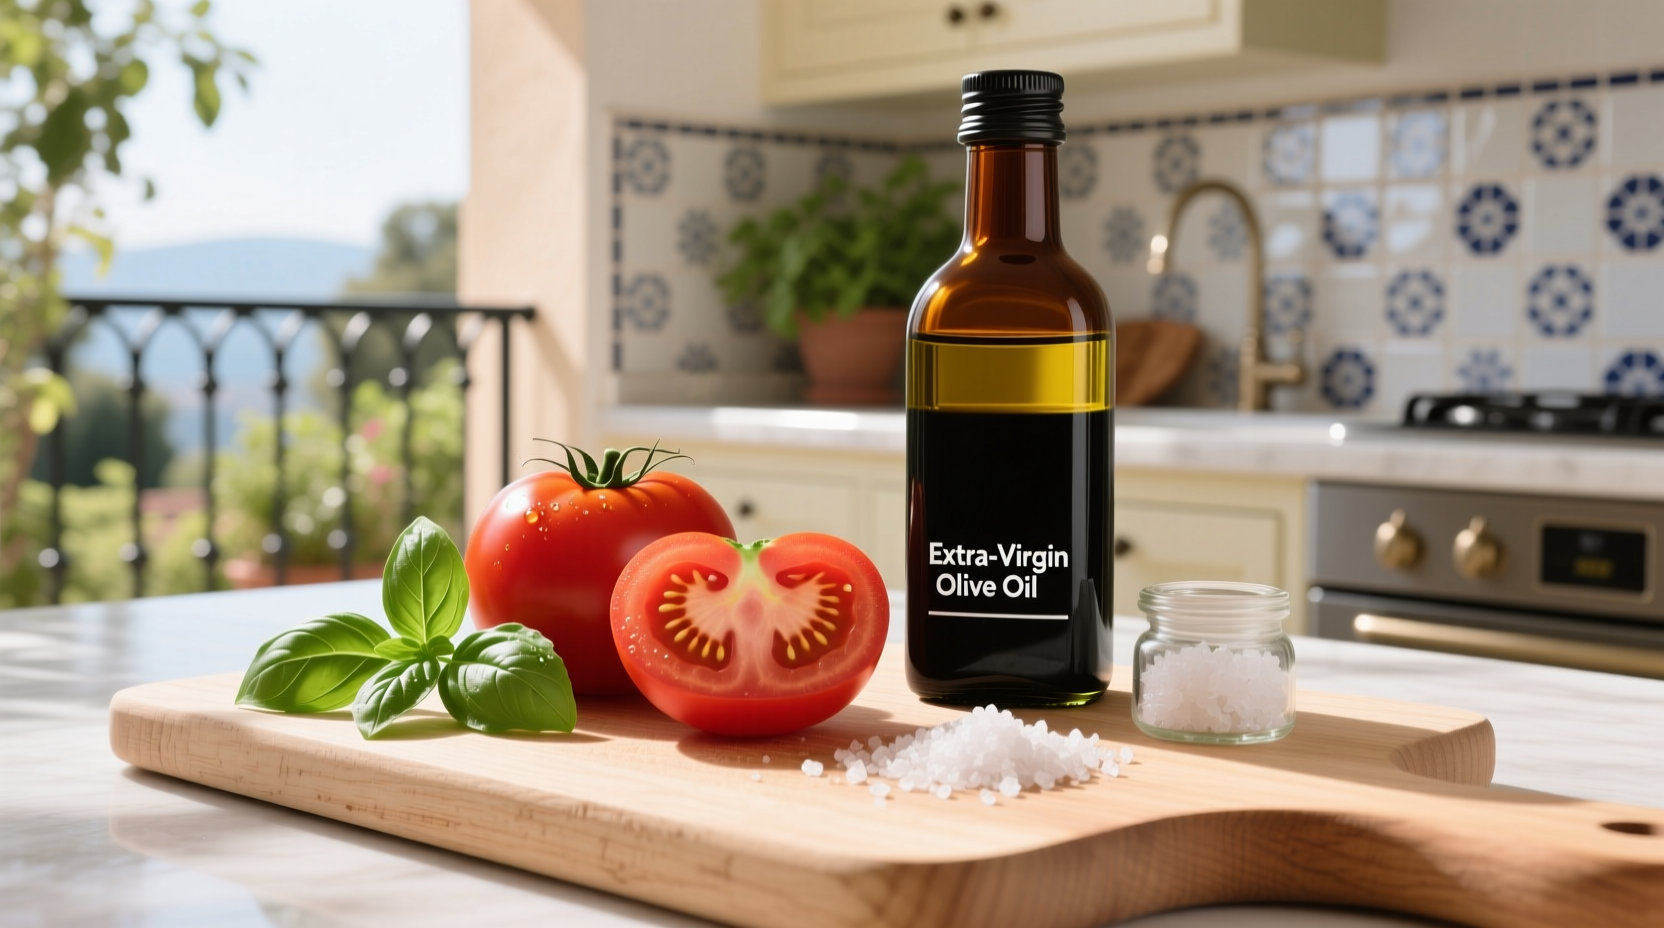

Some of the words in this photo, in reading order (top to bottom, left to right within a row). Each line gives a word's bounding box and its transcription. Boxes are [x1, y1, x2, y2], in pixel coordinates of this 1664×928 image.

[929, 541, 1069, 574] Extra-Virgin
[936, 572, 997, 598] Olive
[1002, 574, 1037, 599] Oil
